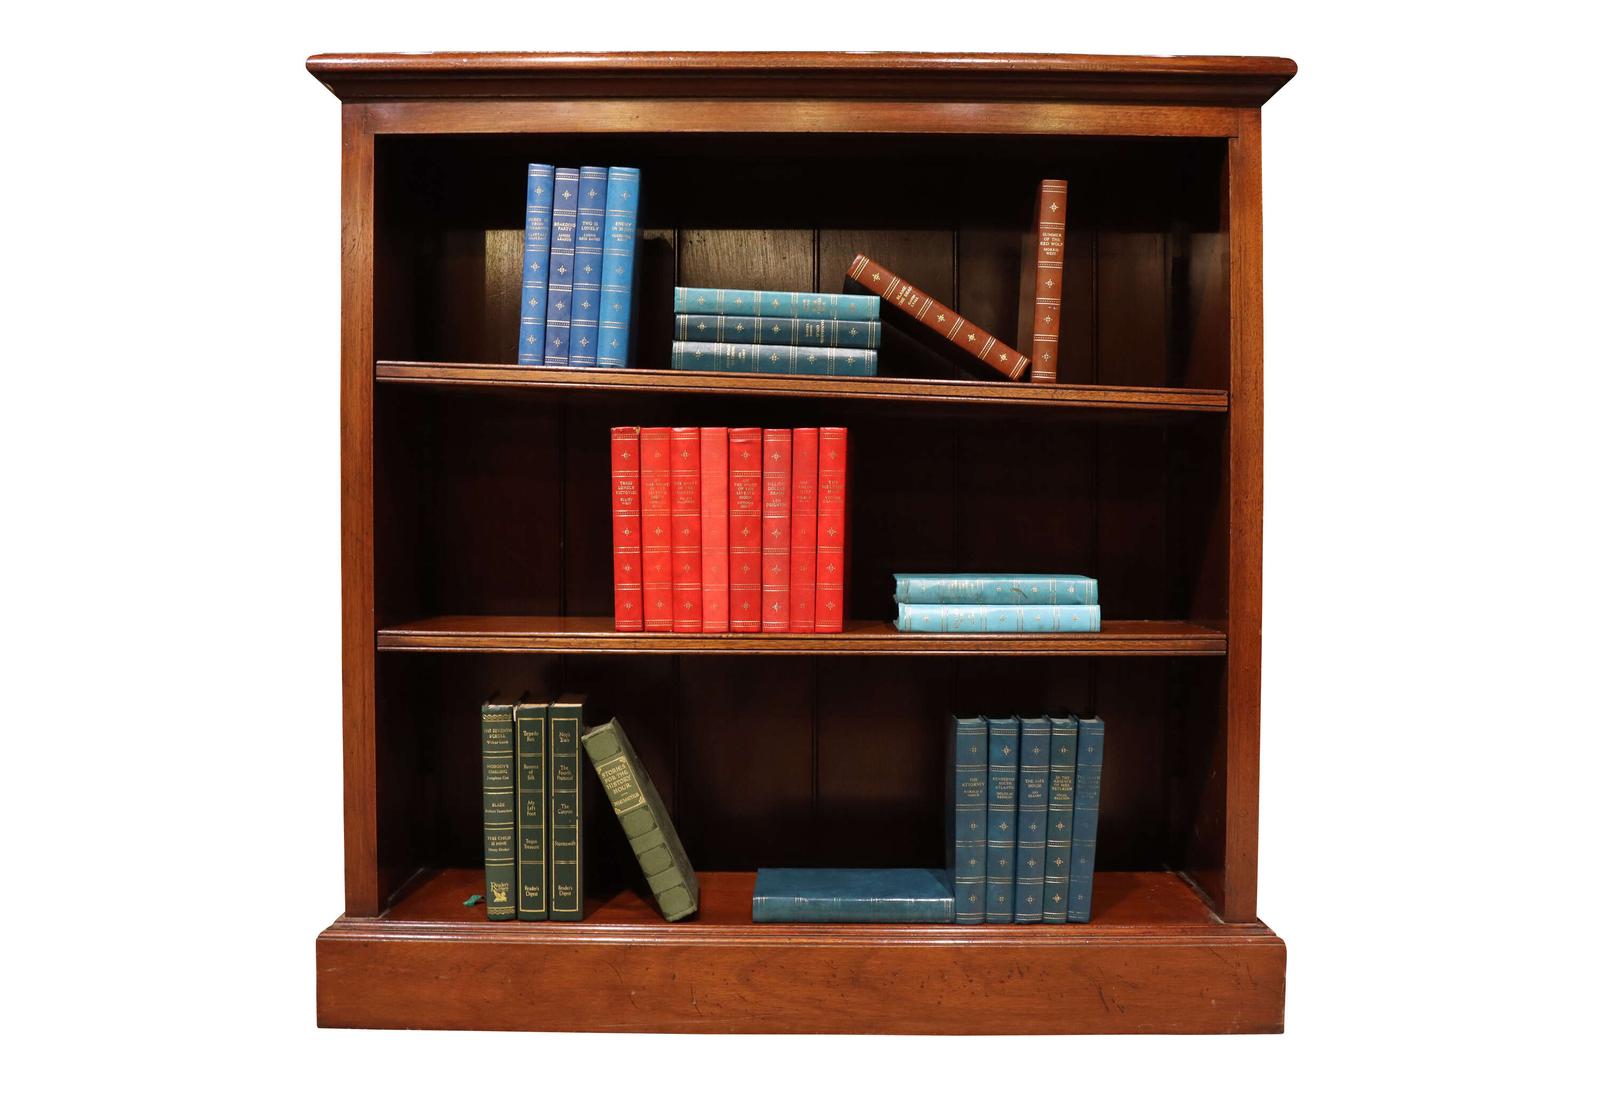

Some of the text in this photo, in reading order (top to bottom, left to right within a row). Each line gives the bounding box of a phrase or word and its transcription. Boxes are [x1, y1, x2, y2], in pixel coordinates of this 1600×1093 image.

[602, 764, 626, 779] STORIES
[604, 770, 629, 783] FOR THE
[606, 775, 631, 790] HISTORY
[613, 782, 631, 794] HOUR
